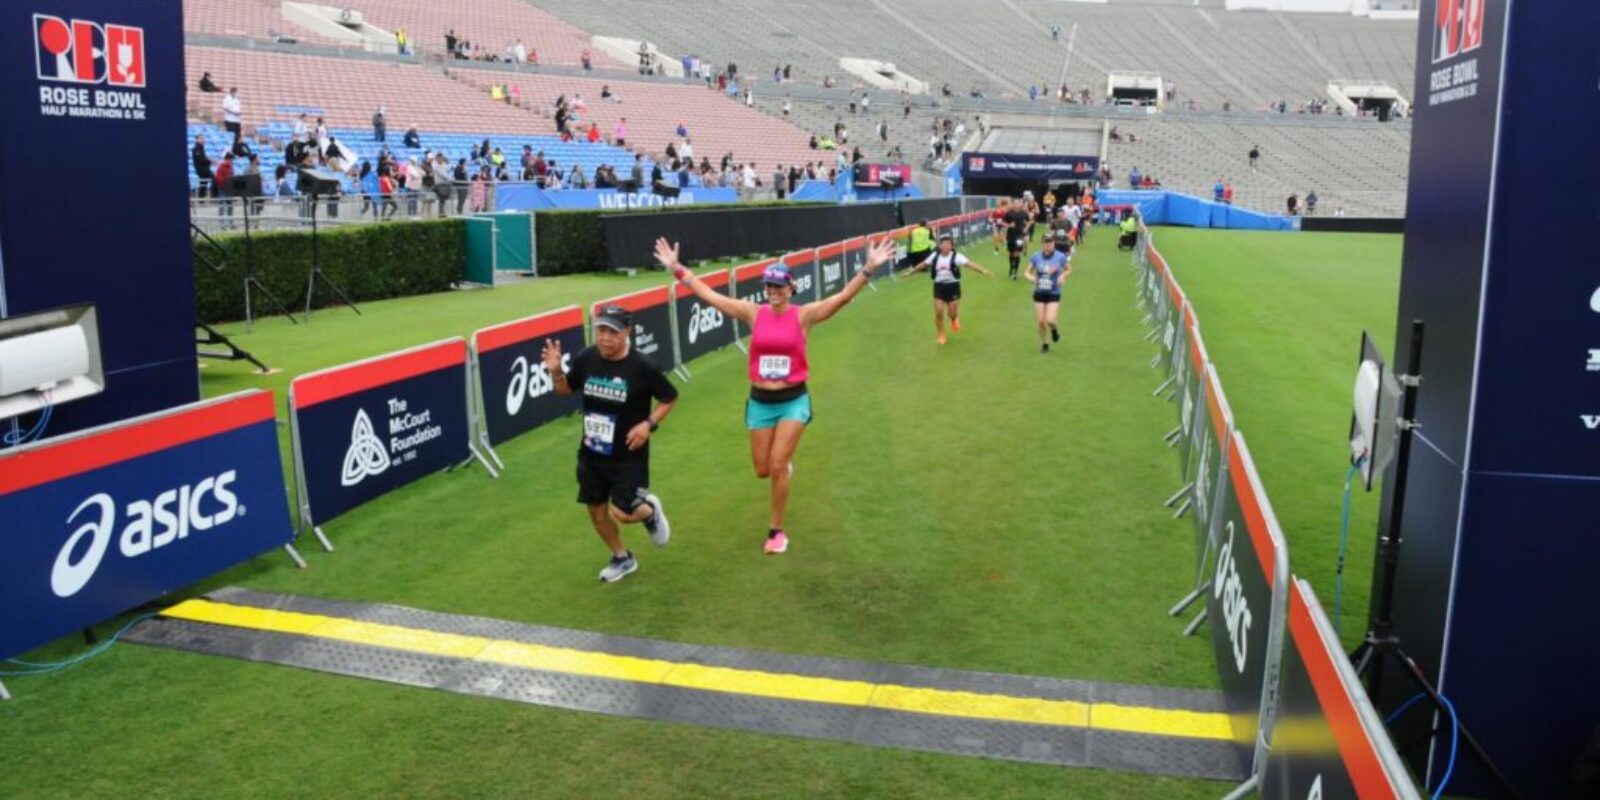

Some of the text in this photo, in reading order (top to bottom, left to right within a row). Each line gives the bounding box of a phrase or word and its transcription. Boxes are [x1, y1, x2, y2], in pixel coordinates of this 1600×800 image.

[40, 86, 146, 109] ROSE BOWL
[41, 105, 67, 116] HALF
[69, 107, 122, 119] MARATHON
[124, 110, 131, 119] &
[388, 397, 407, 415] The
[389, 408, 431, 434] McCourt
[390, 425, 442, 454] Foundation
